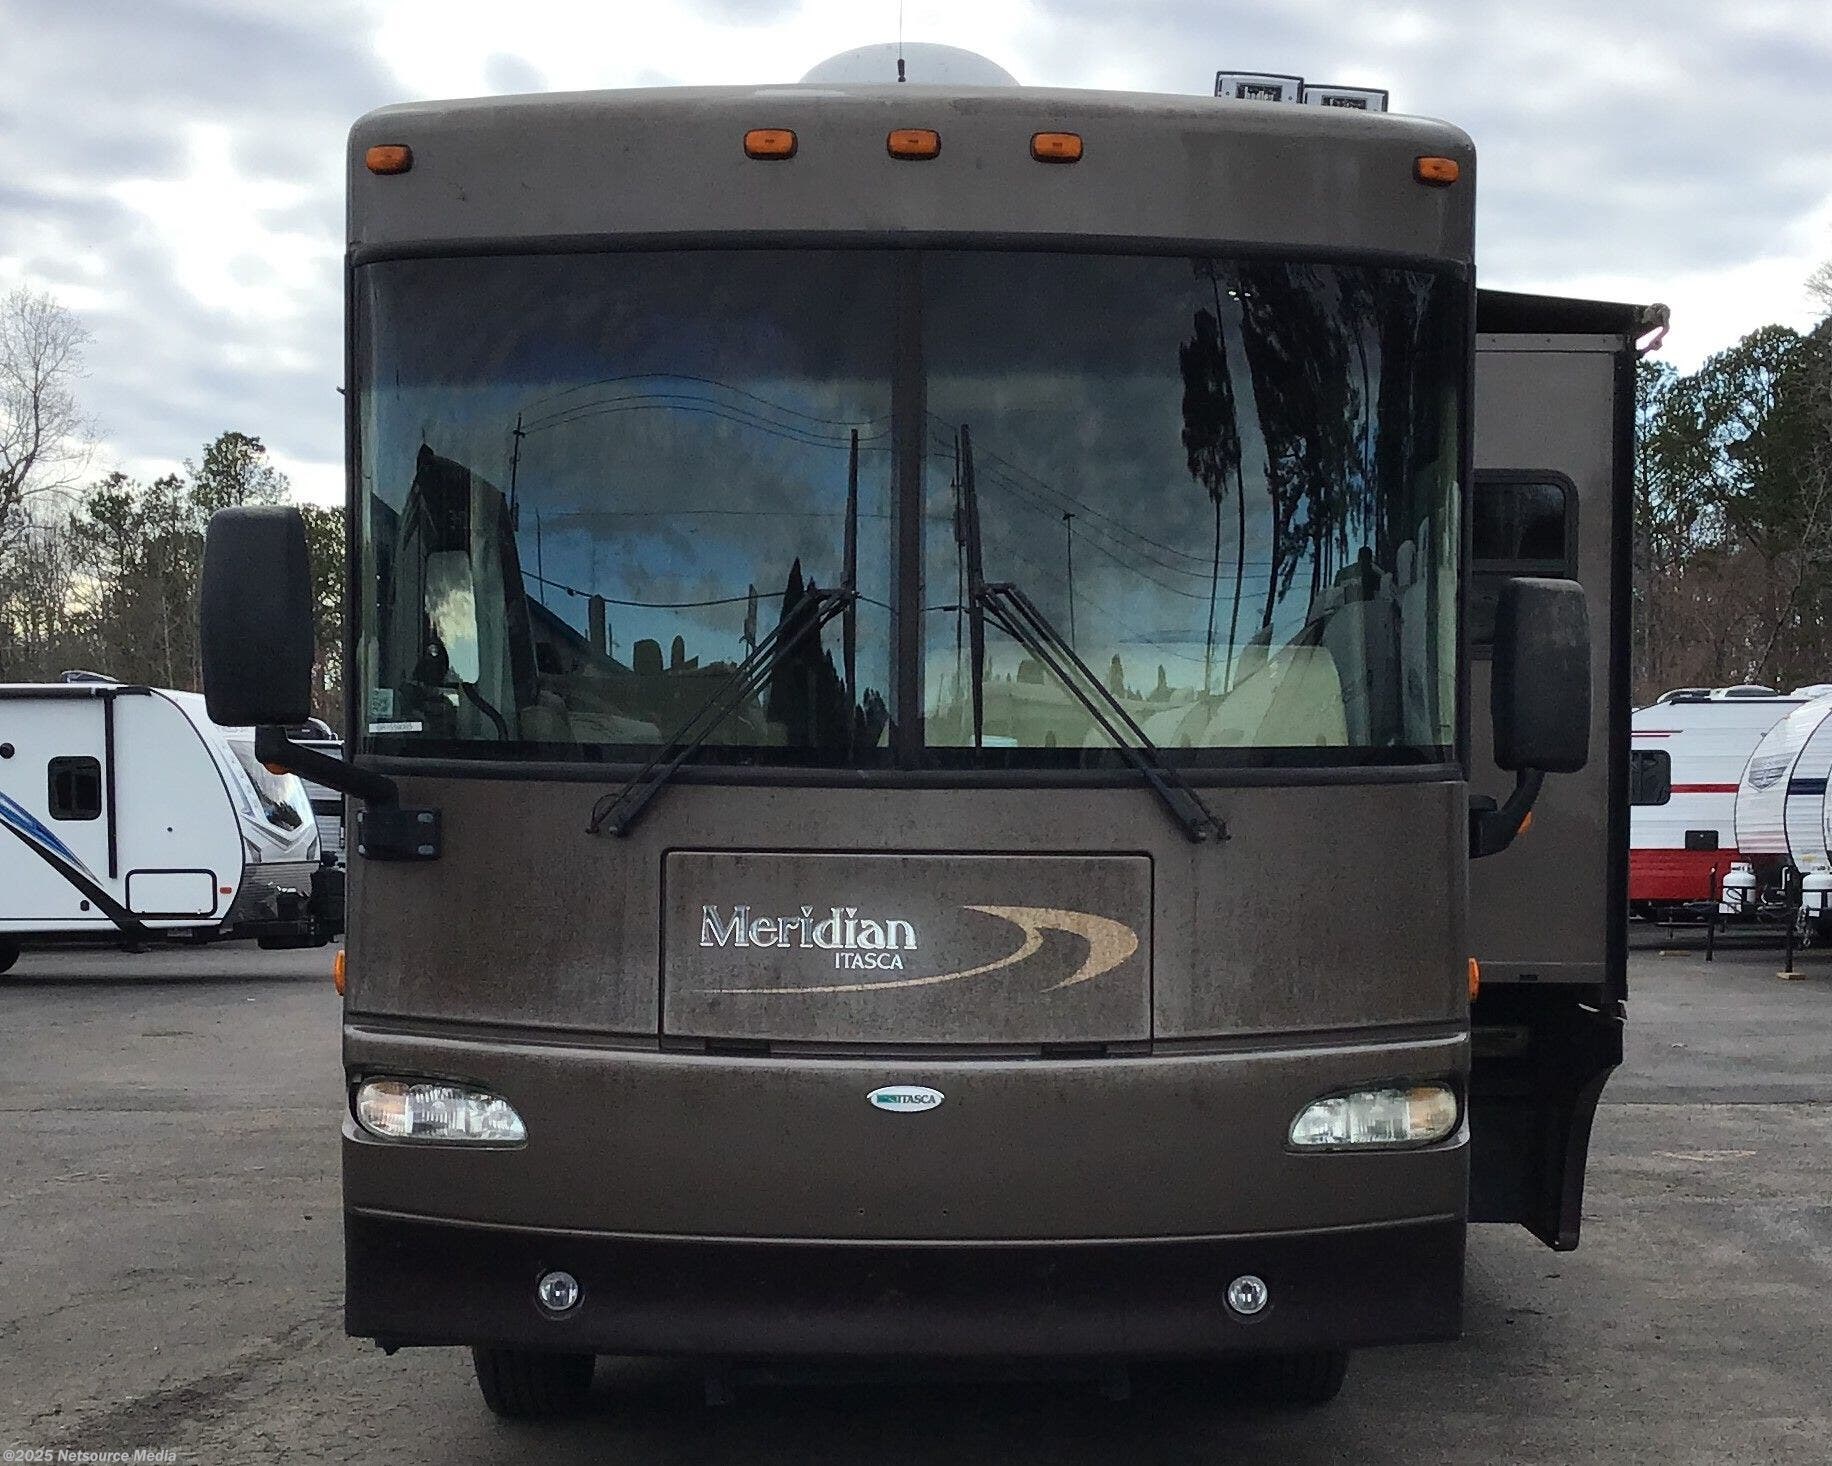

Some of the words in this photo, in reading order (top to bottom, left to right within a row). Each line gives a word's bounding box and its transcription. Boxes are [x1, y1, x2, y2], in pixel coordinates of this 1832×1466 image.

[700, 905, 918, 949] Meridian
[835, 952, 904, 969] ITASCA
[897, 1094, 936, 1104] ITASCA
